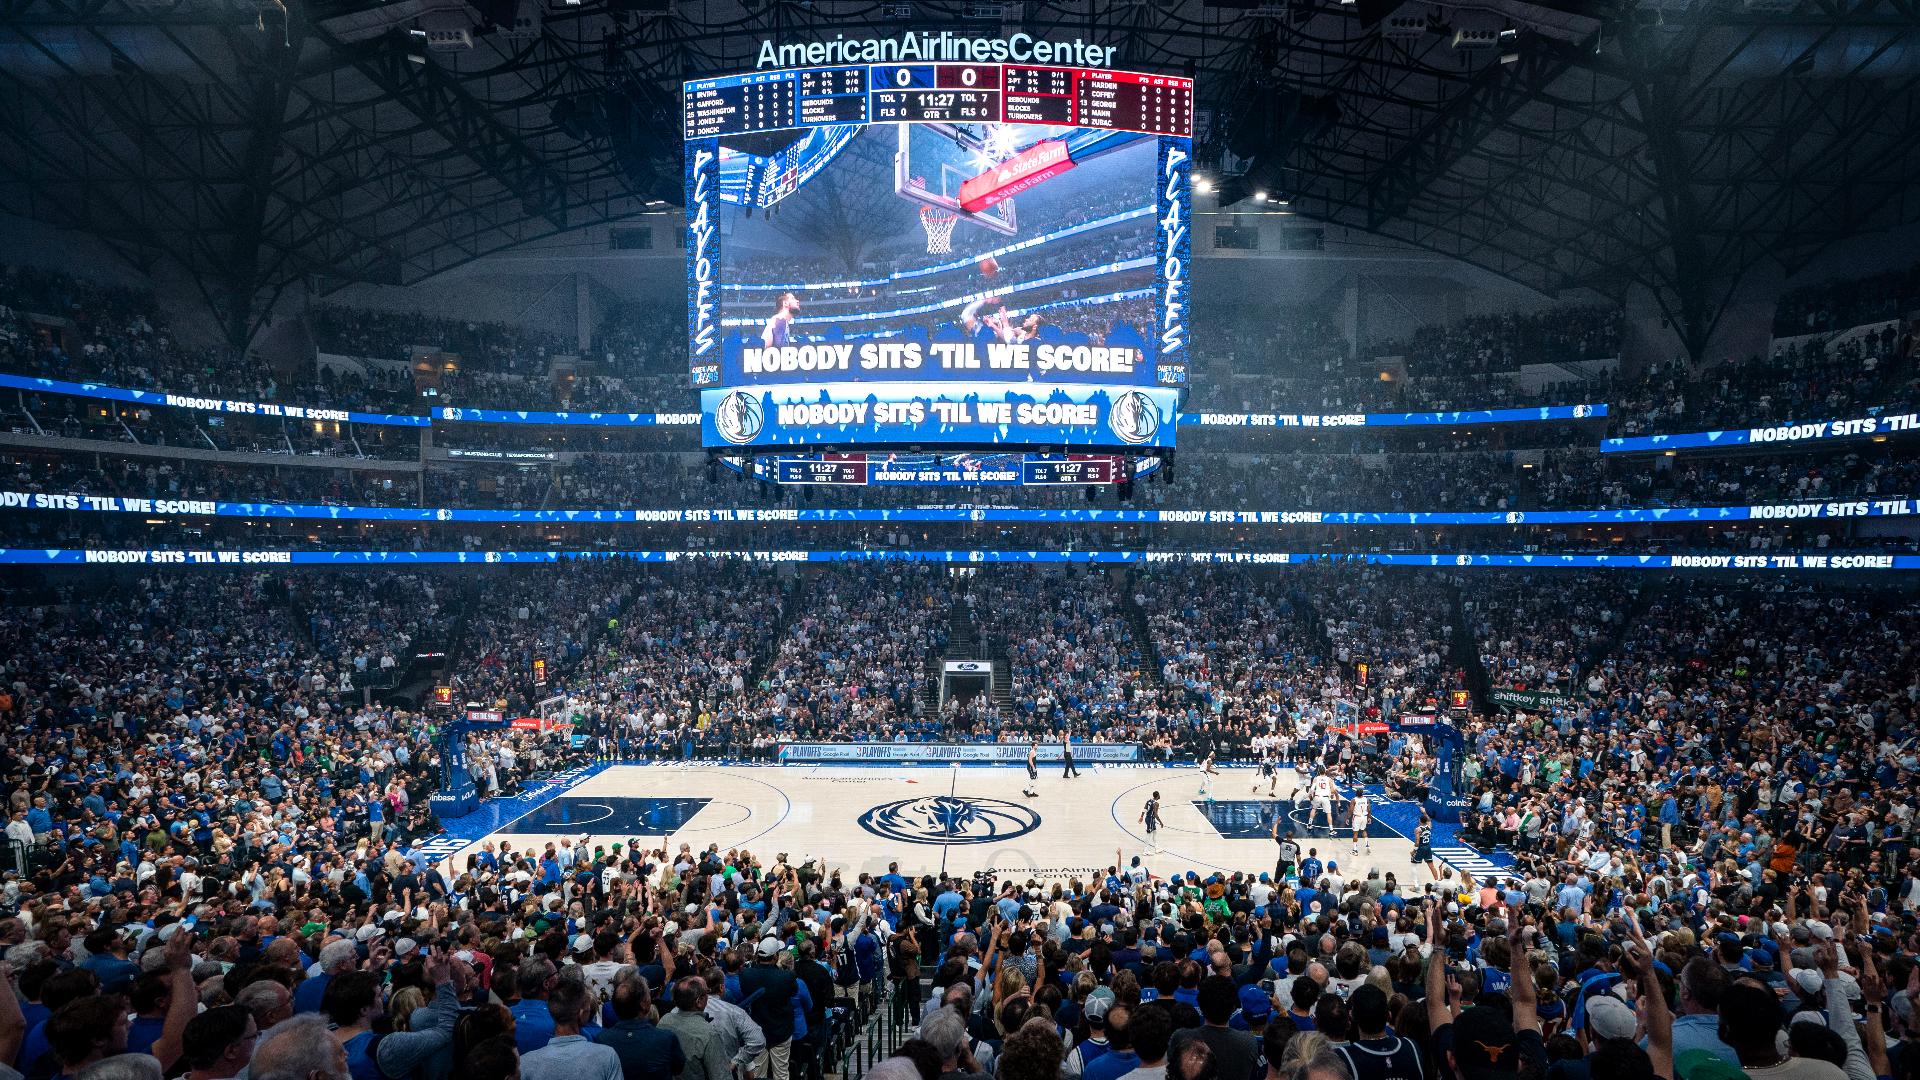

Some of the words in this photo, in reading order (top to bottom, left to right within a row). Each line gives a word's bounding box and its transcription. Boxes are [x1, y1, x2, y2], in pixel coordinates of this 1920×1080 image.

[897, 69, 910, 86] 0
[962, 68, 976, 85] 0
[697, 99, 724, 108] GAFFORD
[918, 94, 954, 106] 11:27
[881, 108, 895, 116] FLS
[961, 108, 976, 116] FLS
[981, 108, 987, 116] 0
[690, 150, 714, 355] PLAYOFFS
[1160, 147, 1187, 354] PLAYOFFS
[743, 345, 853, 372] NOBODY
[860, 343, 922, 369] SITS
[987, 344, 1029, 368] WE
[1037, 344, 1133, 372] SCORE!
[167, 395, 222, 410] NOBODY
[227, 401, 255, 413] SITS
[285, 407, 303, 417] WE
[307, 409, 348, 422] SCORE!
[779, 403, 868, 425] NOBODY
[874, 402, 924, 422] SITS
[978, 403, 1011, 424] WE
[1017, 403, 1097, 425] SCORE!
[1201, 414, 1248, 425] NOBODY
[1251, 414, 1276, 425] SITS
[1302, 415, 1319, 426] WE
[1322, 415, 1365, 426] SCORE!
[1750, 423, 1827, 442] NOBODY
[1832, 418, 1876, 435] SITS
[810, 464, 837, 472] 11:27
[1055, 464, 1081, 472] 11:27
[875, 472, 917, 480] NOBODY
[36, 493, 79, 509] SITS
[123, 498, 151, 512] WE
[156, 500, 215, 514] SCORE!
[636, 510, 682, 521] NOBODY
[685, 510, 710, 521] SITS
[737, 510, 754, 520] WE
[757, 510, 797, 520] SCORE!
[1750, 504, 1822, 518] NOBODY
[1827, 502, 1868, 516] SITS
[1159, 511, 1206, 522] NOBODY
[1210, 511, 1234, 522] SITS
[1261, 512, 1278, 522] WE
[1281, 512, 1321, 523] SCORE!
[86, 551, 147, 562] NOBODY
[152, 551, 185, 562] SITS
[218, 552, 239, 562] WE
[243, 552, 290, 562] SCORE!
[772, 551, 808, 561] SCORE!
[1253, 553, 1289, 563] SCORE!
[1671, 556, 1730, 567] NOBODY
[1735, 556, 1767, 567] SITS
[1803, 556, 1827, 567] WE
[1831, 556, 1892, 568] SCORE!
[1494, 692, 1535, 704] shiftkey
[793, 747, 821, 757] PLAYOFFS
[862, 747, 890, 757] PLAYOFFS
[932, 747, 961, 758] PLAYOFFS
[1072, 748, 1101, 758] PLAYOFFS
[1422, 836, 1429, 844] 25
